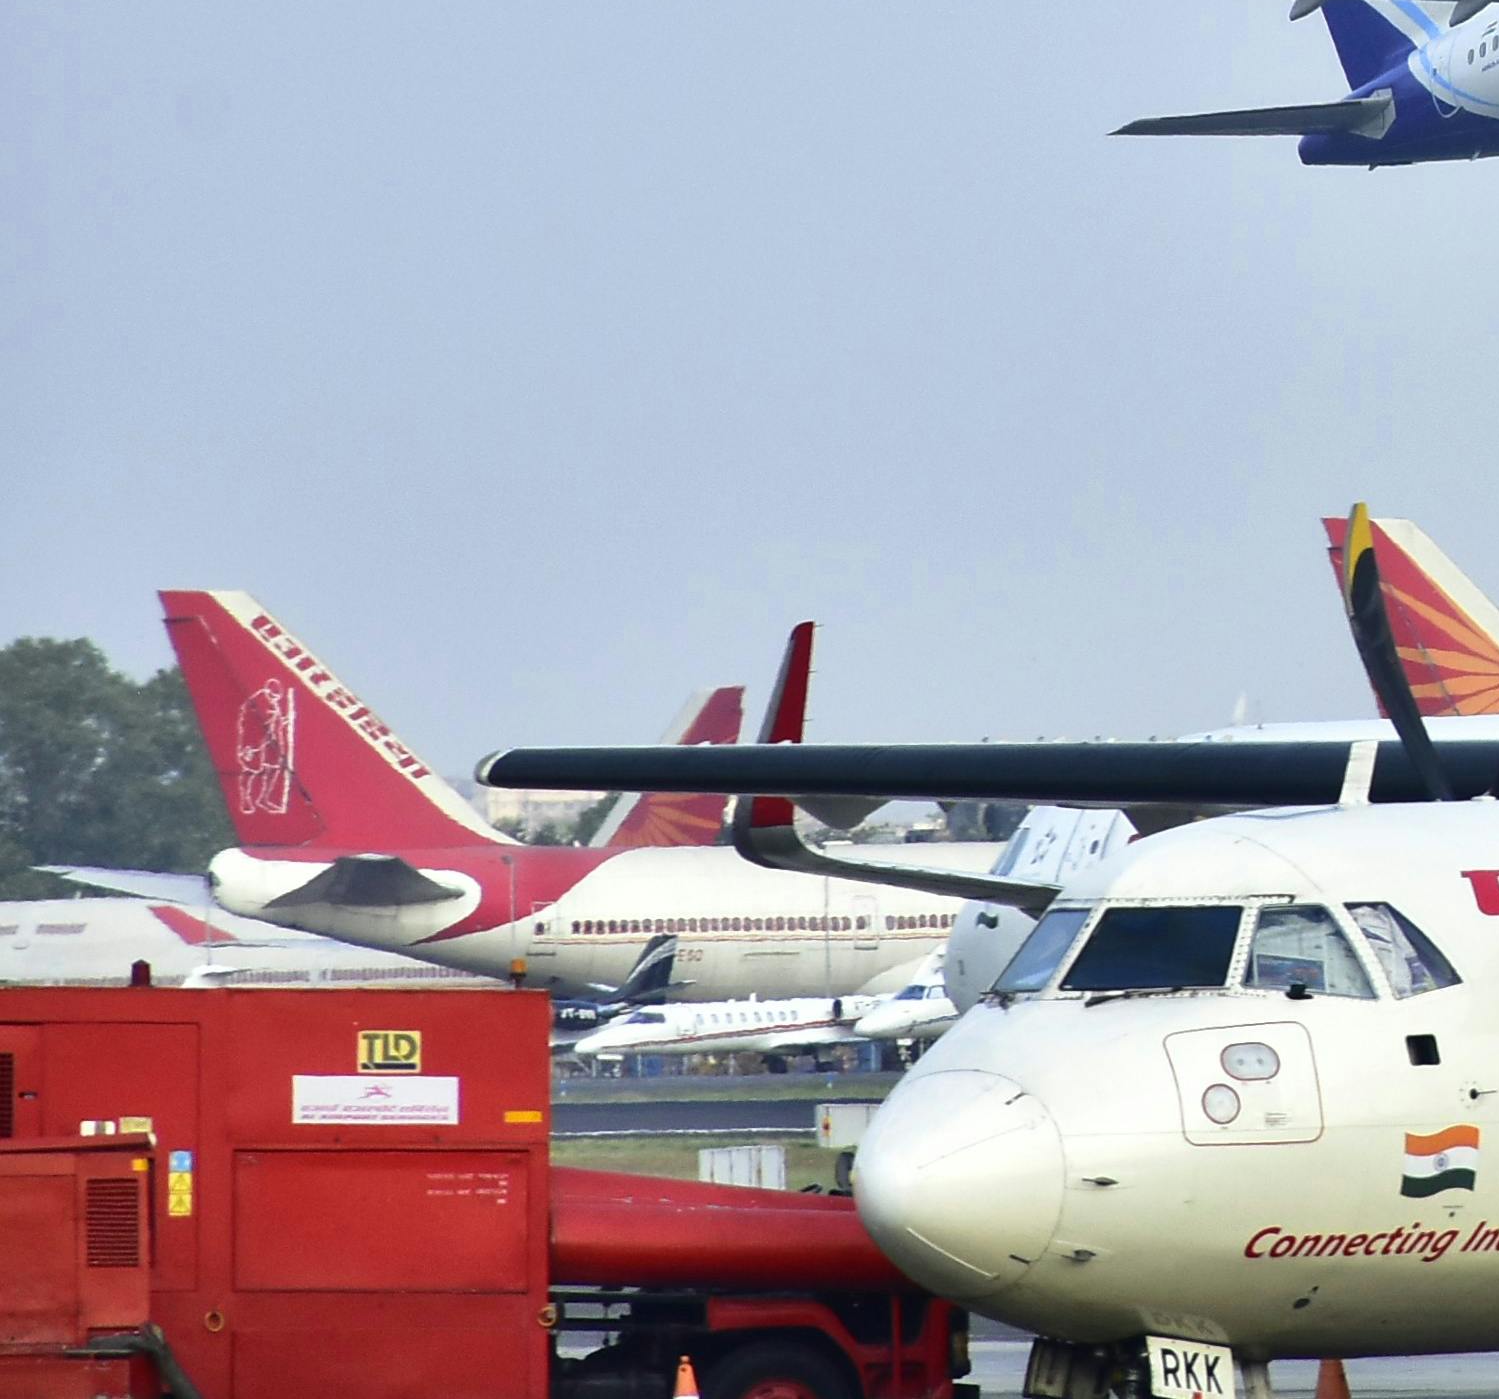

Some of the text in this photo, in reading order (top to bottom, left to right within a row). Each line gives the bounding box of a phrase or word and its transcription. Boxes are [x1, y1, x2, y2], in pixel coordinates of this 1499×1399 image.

[361, 1032, 418, 1065] TLD
[1244, 1222, 1460, 1263] Connecting
[1160, 1347, 1224, 1395] RKK
